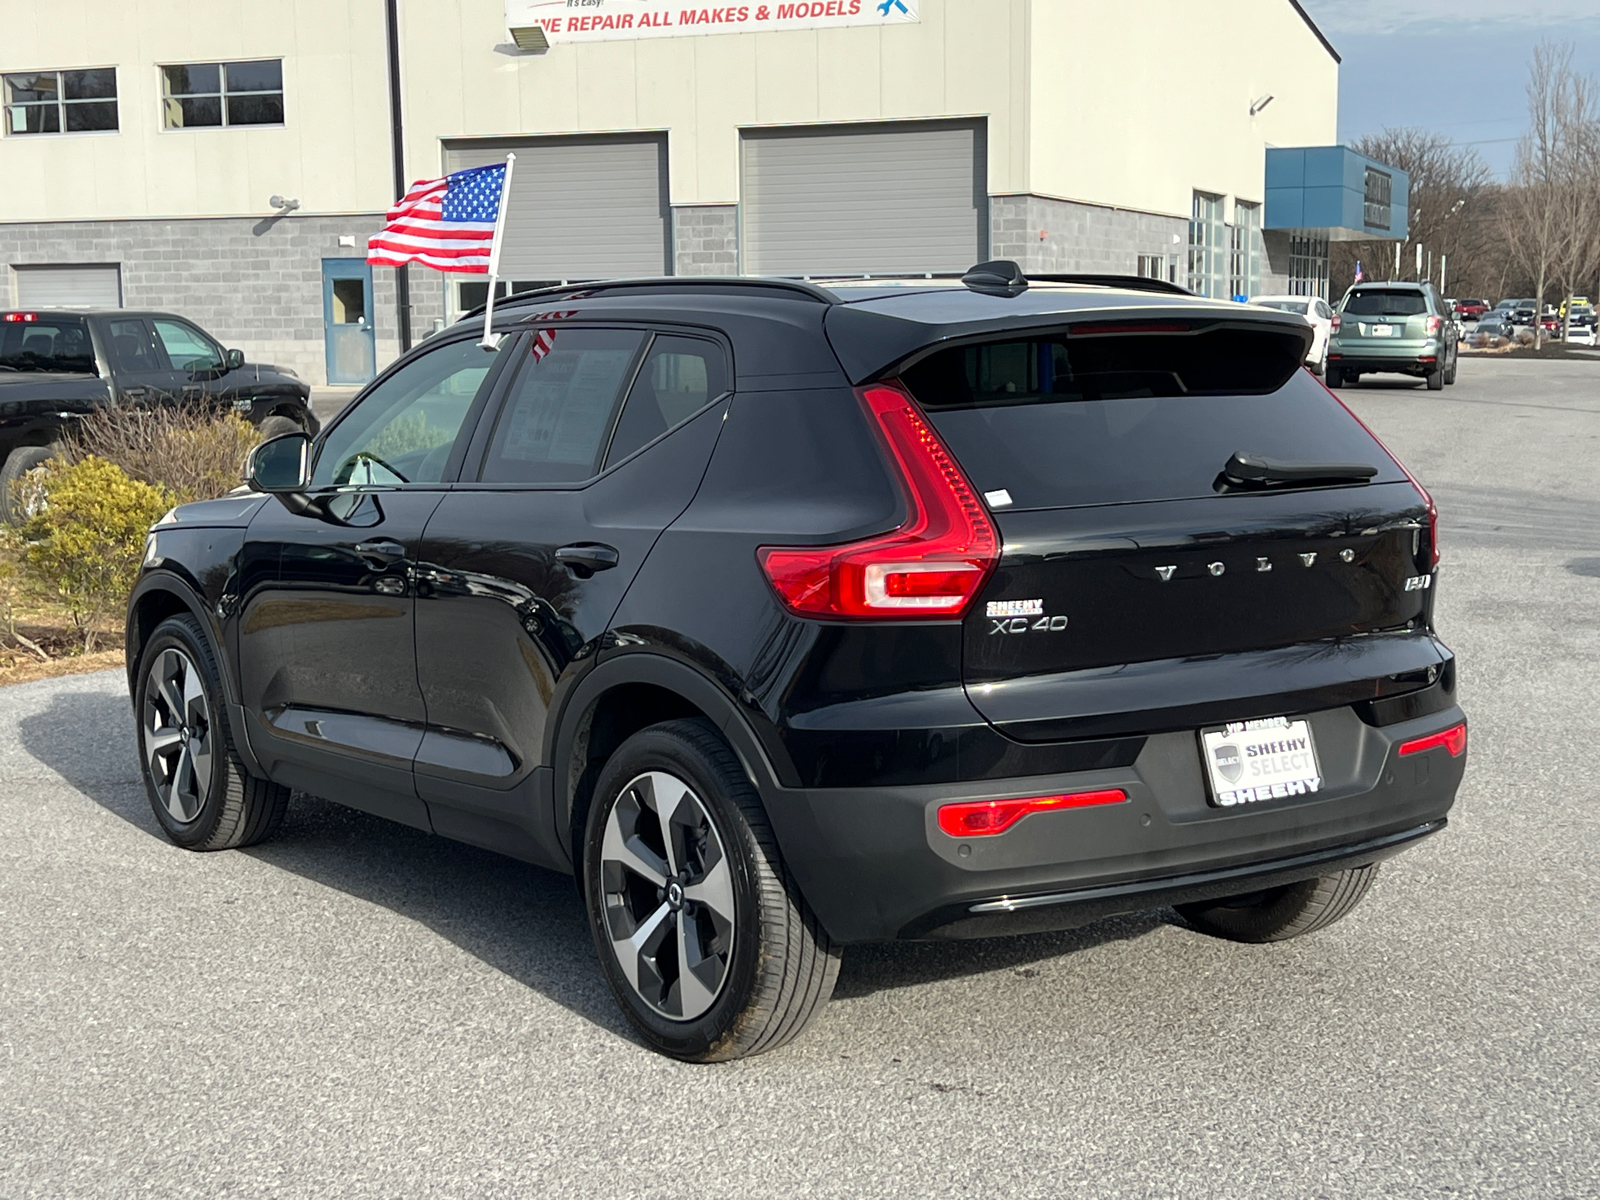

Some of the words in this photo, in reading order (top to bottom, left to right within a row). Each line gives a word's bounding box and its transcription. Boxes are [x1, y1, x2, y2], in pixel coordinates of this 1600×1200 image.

[567, 14, 634, 32] REPAIR
[637, 11, 673, 28] ALL
[678, 6, 750, 26] MAKES
[755, 5, 771, 21] &
[776, 0, 861, 20] MODELS
[1155, 548, 1355, 581] VOLVO
[986, 598, 1043, 611] SHEEHY
[1245, 737, 1306, 757] SHEEHY
[1250, 752, 1310, 777] SELECT
[1219, 777, 1321, 806] SHEEHY
